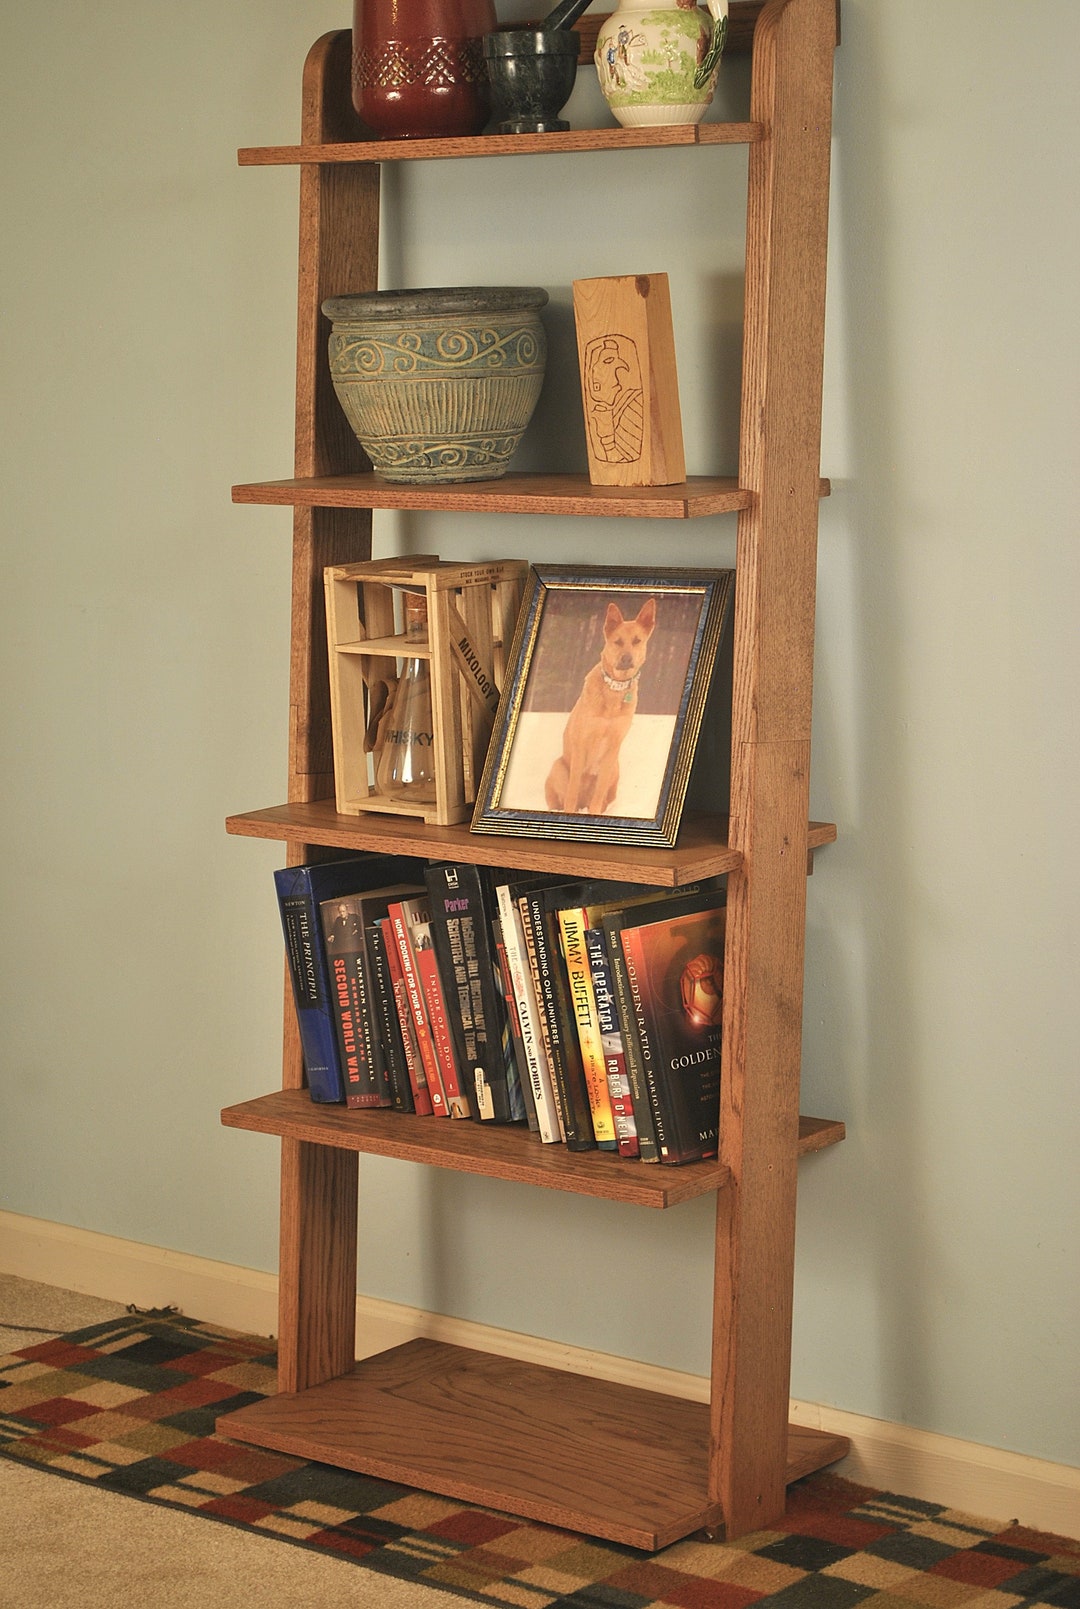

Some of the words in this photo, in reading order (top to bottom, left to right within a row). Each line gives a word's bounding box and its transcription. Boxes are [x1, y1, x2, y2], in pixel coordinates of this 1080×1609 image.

[458, 637, 494, 699] MIXOLOGY
[384, 730, 434, 747] WHISKY
[299, 912, 310, 938] THE
[444, 898, 470, 913] Parker
[394, 918, 405, 939] HOME
[446, 918, 464, 965] SCIENTIFIC
[531, 901, 550, 977] UNDERSTANDING
[563, 919, 583, 965] JIMMY
[609, 930, 618, 949] ROSS
[624, 936, 632, 954] THE
[303, 942, 318, 1000] PRINCIPIA
[372, 933, 380, 951] The
[376, 956, 386, 994] Elegant
[399, 939, 412, 972] COOKING
[454, 966, 468, 984] AND
[589, 944, 604, 967] THE
[334, 959, 350, 1008] SECOND
[406, 972, 416, 989] FOR
[543, 979, 553, 1000] OUR
[613, 958, 626, 997] Introduction
[627, 956, 643, 1013] GOLDEN
[351, 978, 361, 1023] MEMOIRS
[357, 1028, 363, 1039] OF
[356, 958, 366, 1005] WINSTON
[363, 1021, 374, 1081] CHURCHILL
[410, 989, 421, 1010] YOUR
[415, 1010, 424, 1026] DOG
[457, 984, 473, 1030] TECHNICAL
[572, 970, 592, 1028] BUFFETT
[593, 971, 614, 1032] OPERATOR
[621, 1004, 630, 1033] Ordinary
[341, 1010, 356, 1053] WORLD
[429, 974, 441, 1011] INSIDE
[438, 1016, 445, 1029] OF
[443, 1046, 452, 1069] DOG
[476, 1032, 488, 1043] OF
[547, 1002, 560, 1045] UNIVERSE
[637, 1018, 652, 1060] RATIO
[400, 1018, 414, 1070] GILGAMESH
[464, 1031, 478, 1061] TERMS
[518, 1001, 533, 1044] CALVIN
[528, 1057, 543, 1100] HOBBES
[625, 1033, 637, 1069] Differential
[670, 1047, 722, 1071] GOLDEN
[347, 1056, 360, 1083] WAR
[607, 1059, 624, 1100] ROBERT
[630, 1068, 640, 1100] Equations
[615, 1104, 631, 1146] O'NEILL
[647, 1070, 660, 1107] MARIO
[654, 1111, 665, 1141] LIVIO
